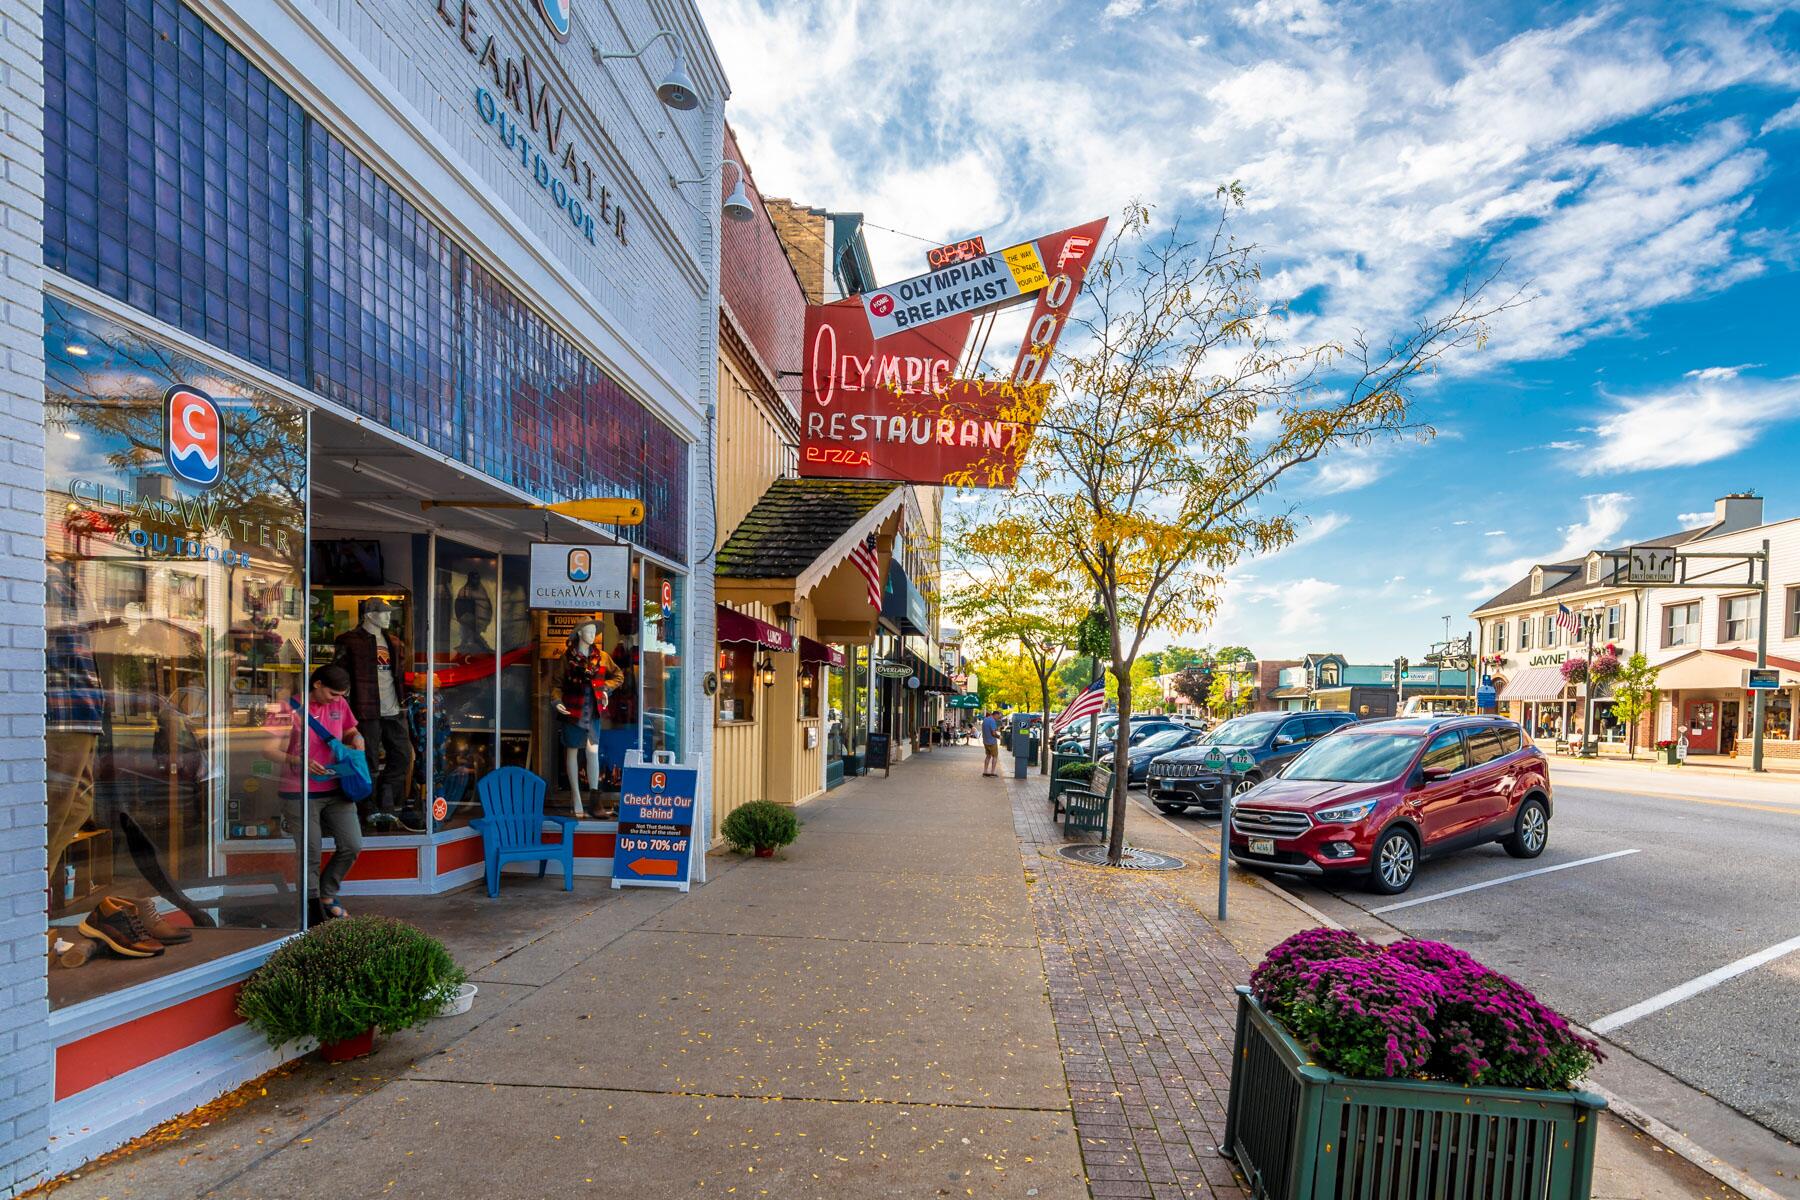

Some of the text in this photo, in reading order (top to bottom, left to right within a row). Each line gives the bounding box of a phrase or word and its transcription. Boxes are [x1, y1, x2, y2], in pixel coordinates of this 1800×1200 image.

[476, 87, 596, 246] OUTDOOR
[929, 236, 984, 267] OPEN
[1020, 250, 1032, 259] WAY
[1012, 262, 1039, 275] TO START
[899, 257, 997, 302] OLYMPIAN
[1018, 274, 1045, 287] YOUR DAY
[873, 296, 889, 309] HOME
[880, 305, 887, 313] OF
[894, 277, 1008, 328] BREAKFAST
[1014, 236, 1093, 388] FOOD
[812, 323, 951, 406] OLYMPIC
[808, 412, 1022, 448] RESTAURANT
[806, 447, 872, 466] PIZZA
[68, 478, 290, 551] CLEARWATER
[129, 528, 251, 568] OUTDOOR
[536, 584, 621, 599] CLEARWATER
[767, 629, 781, 644] LUNCH
[1530, 653, 1566, 666] JAYNE
[877, 665, 911, 674] OVERLAND
[1541, 705, 1560, 713] JAYNE
[623, 794, 691, 807] Check Out Our
[640, 808, 673, 819] Behind
[620, 838, 687, 851] Up to 70% off
